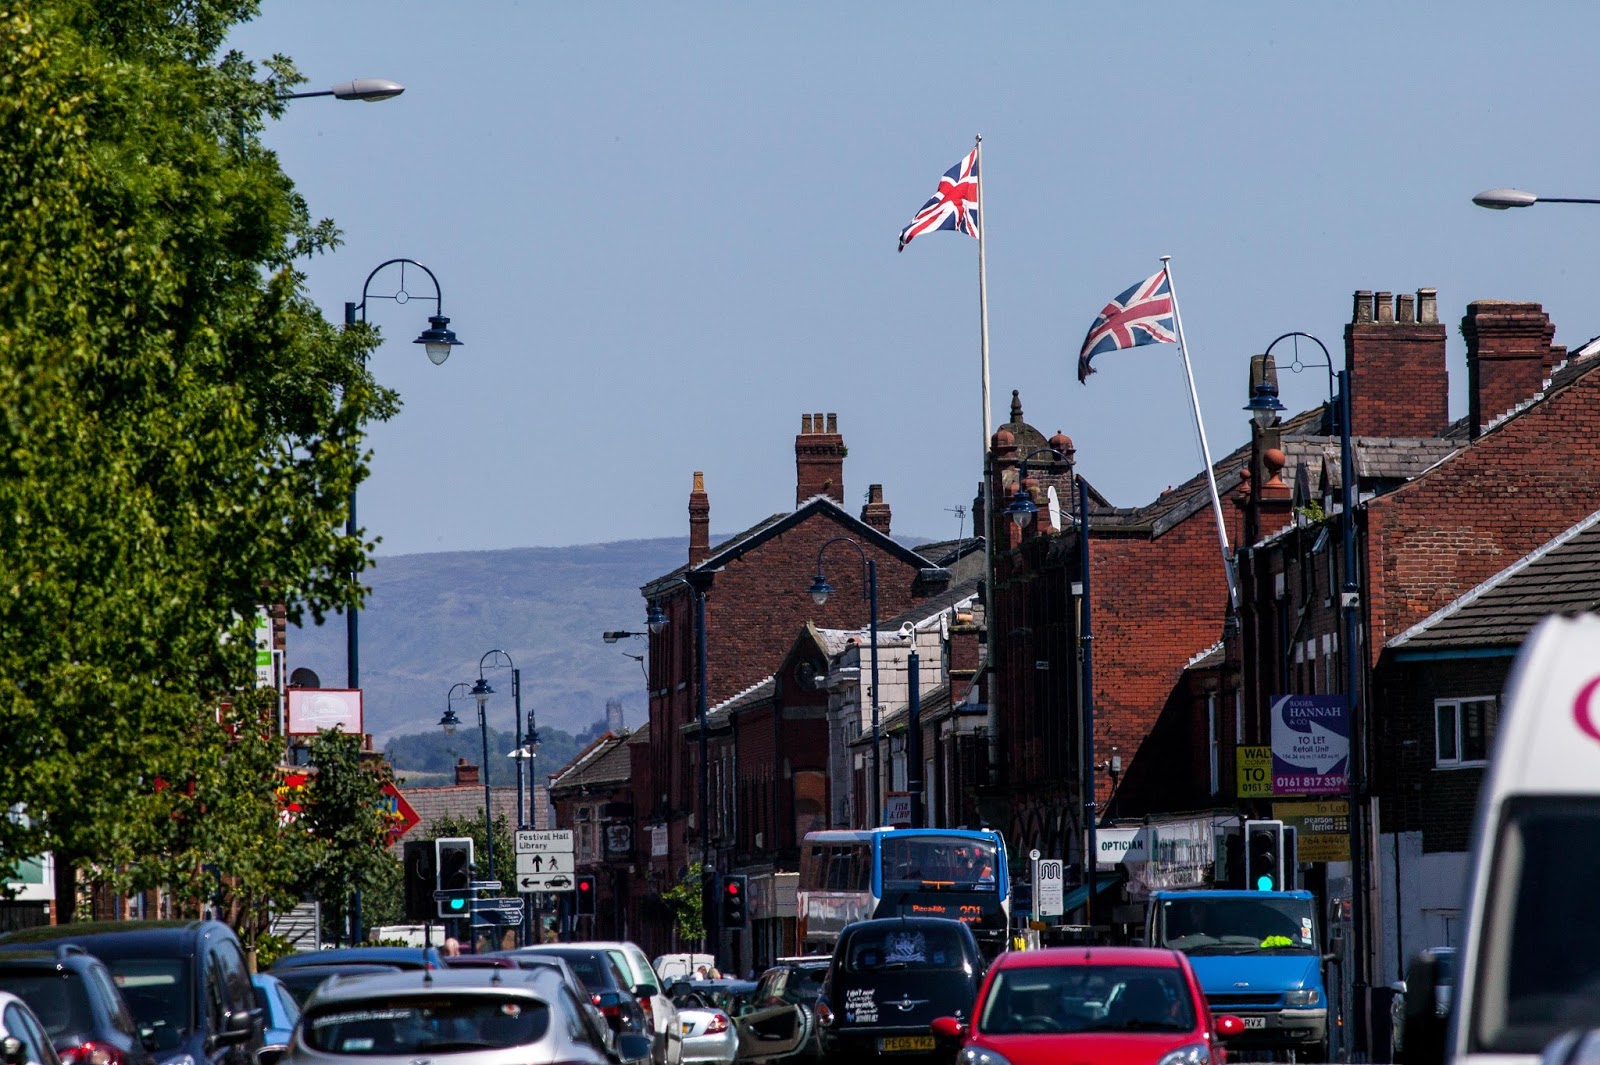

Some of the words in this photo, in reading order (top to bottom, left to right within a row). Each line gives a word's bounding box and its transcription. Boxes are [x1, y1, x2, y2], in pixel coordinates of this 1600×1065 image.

[1290, 707, 1341, 717] HANNAH
[1298, 736, 1310, 744] TO
[1313, 736, 1325, 744] LET
[1293, 745, 1313, 753] Retail
[1315, 745, 1329, 753] Unit
[1243, 768, 1265, 781] TO
[1277, 777, 1300, 787] 0161
[1303, 777, 1321, 787] 817
[1243, 783, 1261, 792] 0161
[1315, 804, 1326, 812] To
[1330, 804, 1346, 812] Let
[1304, 817, 1333, 825] pearson
[519, 842, 547, 850] Library
[1101, 840, 1143, 851] OPTICIAN
[1244, 1018, 1262, 1027] RVX
